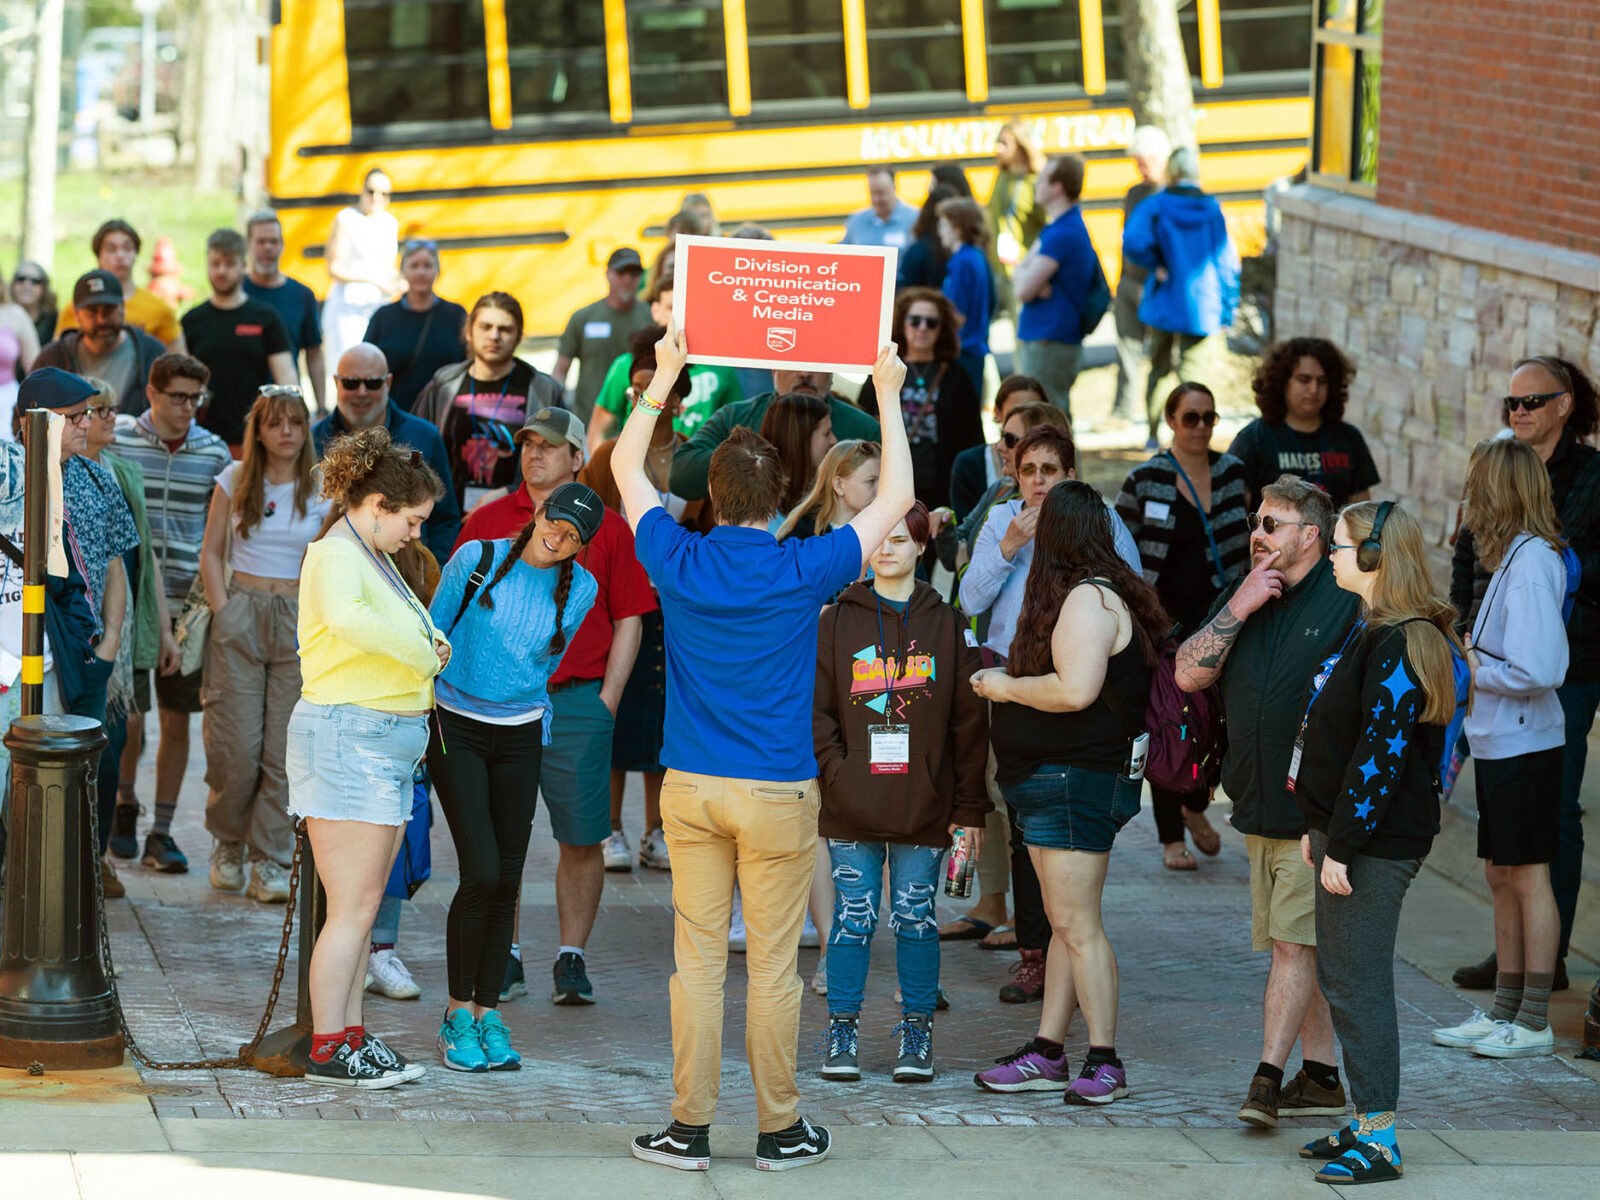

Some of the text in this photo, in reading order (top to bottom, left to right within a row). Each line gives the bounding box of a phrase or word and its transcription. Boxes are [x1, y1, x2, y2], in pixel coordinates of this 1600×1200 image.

[861, 115, 1046, 160] MOUNTN
[734, 257, 839, 276] Division of
[708, 271, 861, 292] Communication
[732, 288, 836, 306] & Creative
[752, 305, 813, 321] Media
